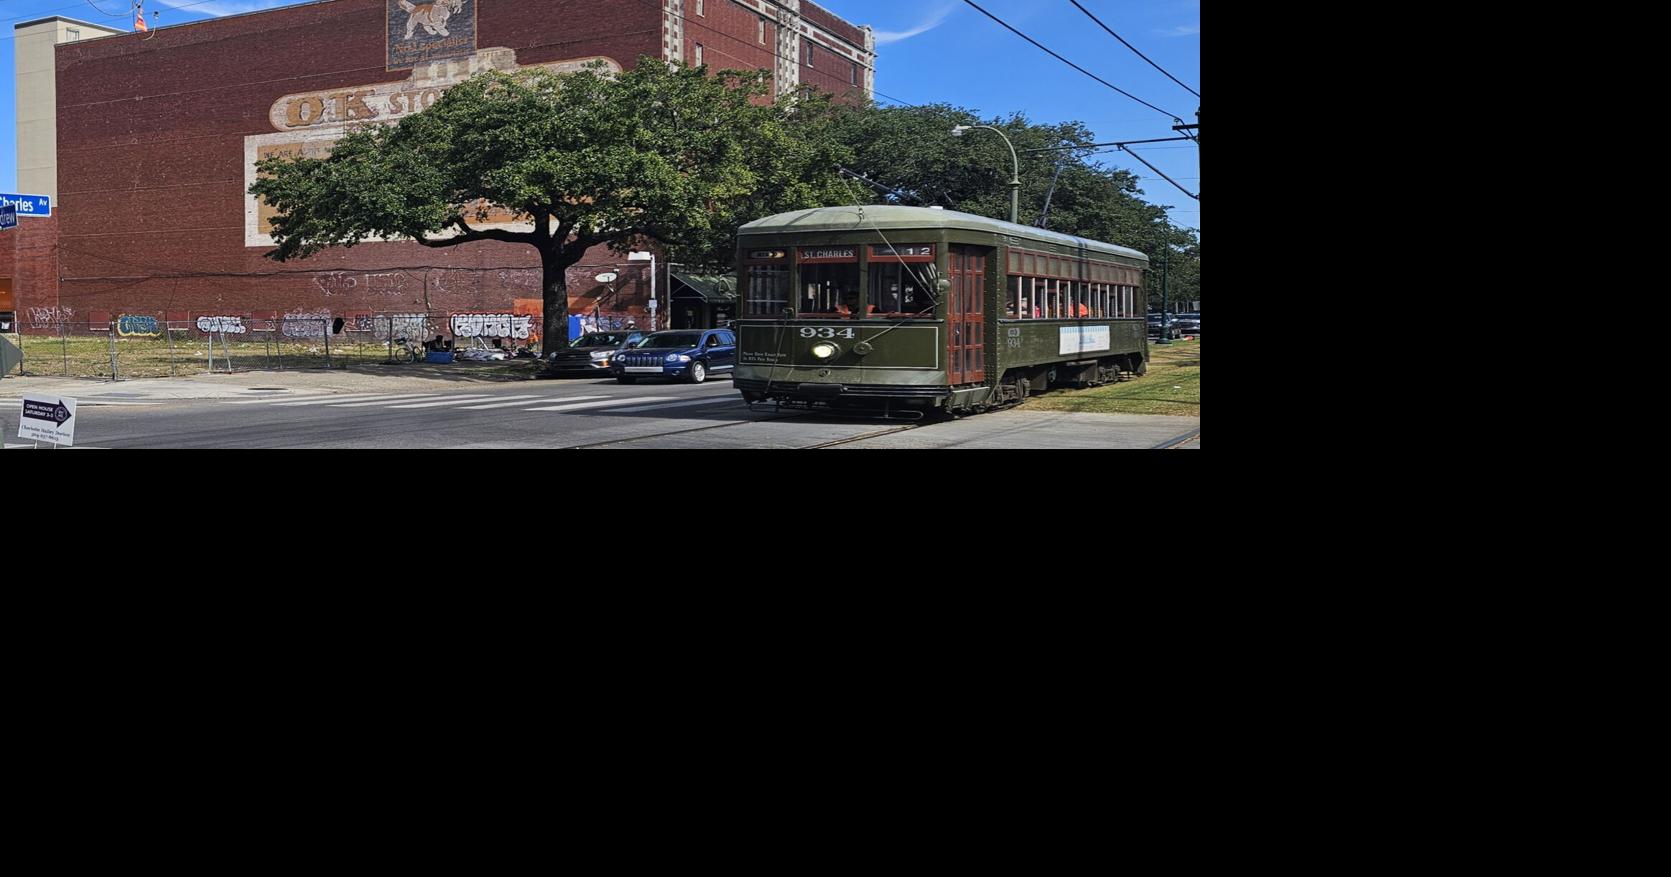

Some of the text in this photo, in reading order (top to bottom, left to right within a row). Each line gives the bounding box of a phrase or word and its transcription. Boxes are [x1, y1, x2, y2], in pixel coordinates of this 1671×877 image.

[286, 89, 380, 127] OK
[816, 249, 854, 258] CHARLES
[800, 327, 855, 339] 934
[25, 408, 46, 416] SATURDAY
